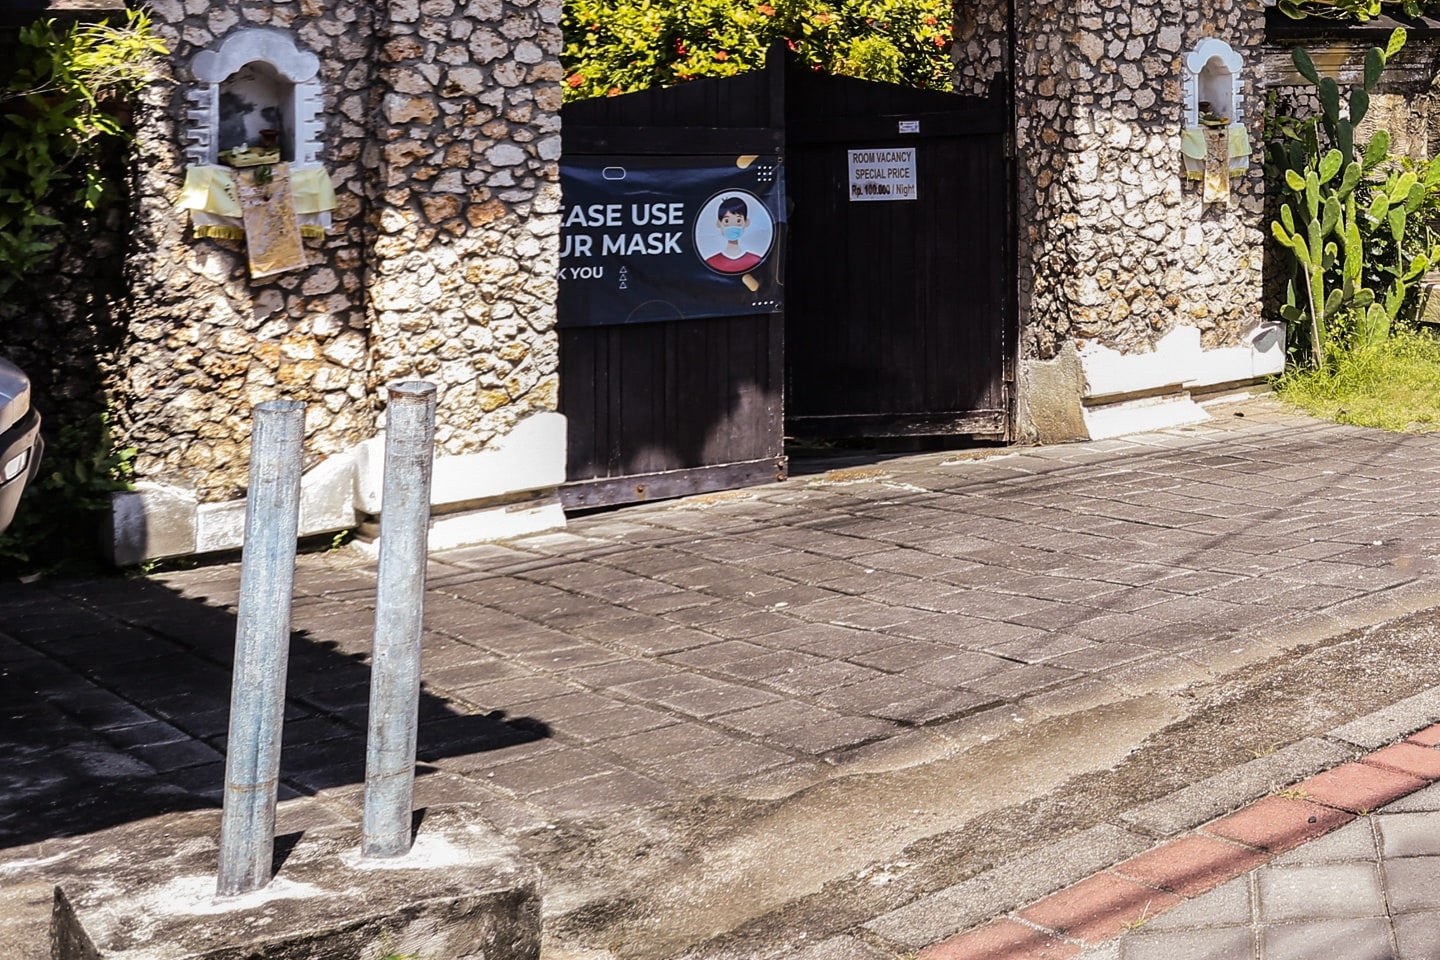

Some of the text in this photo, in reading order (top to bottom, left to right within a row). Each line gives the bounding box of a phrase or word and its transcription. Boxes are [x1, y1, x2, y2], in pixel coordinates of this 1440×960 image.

[852, 151, 912, 164] ROOM VACANCY
[855, 167, 910, 180] SPECIAL PRICE
[896, 183, 915, 197] Night
[631, 202, 685, 226] USE
[601, 231, 683, 256] MASK
[570, 266, 604, 280] YOU
